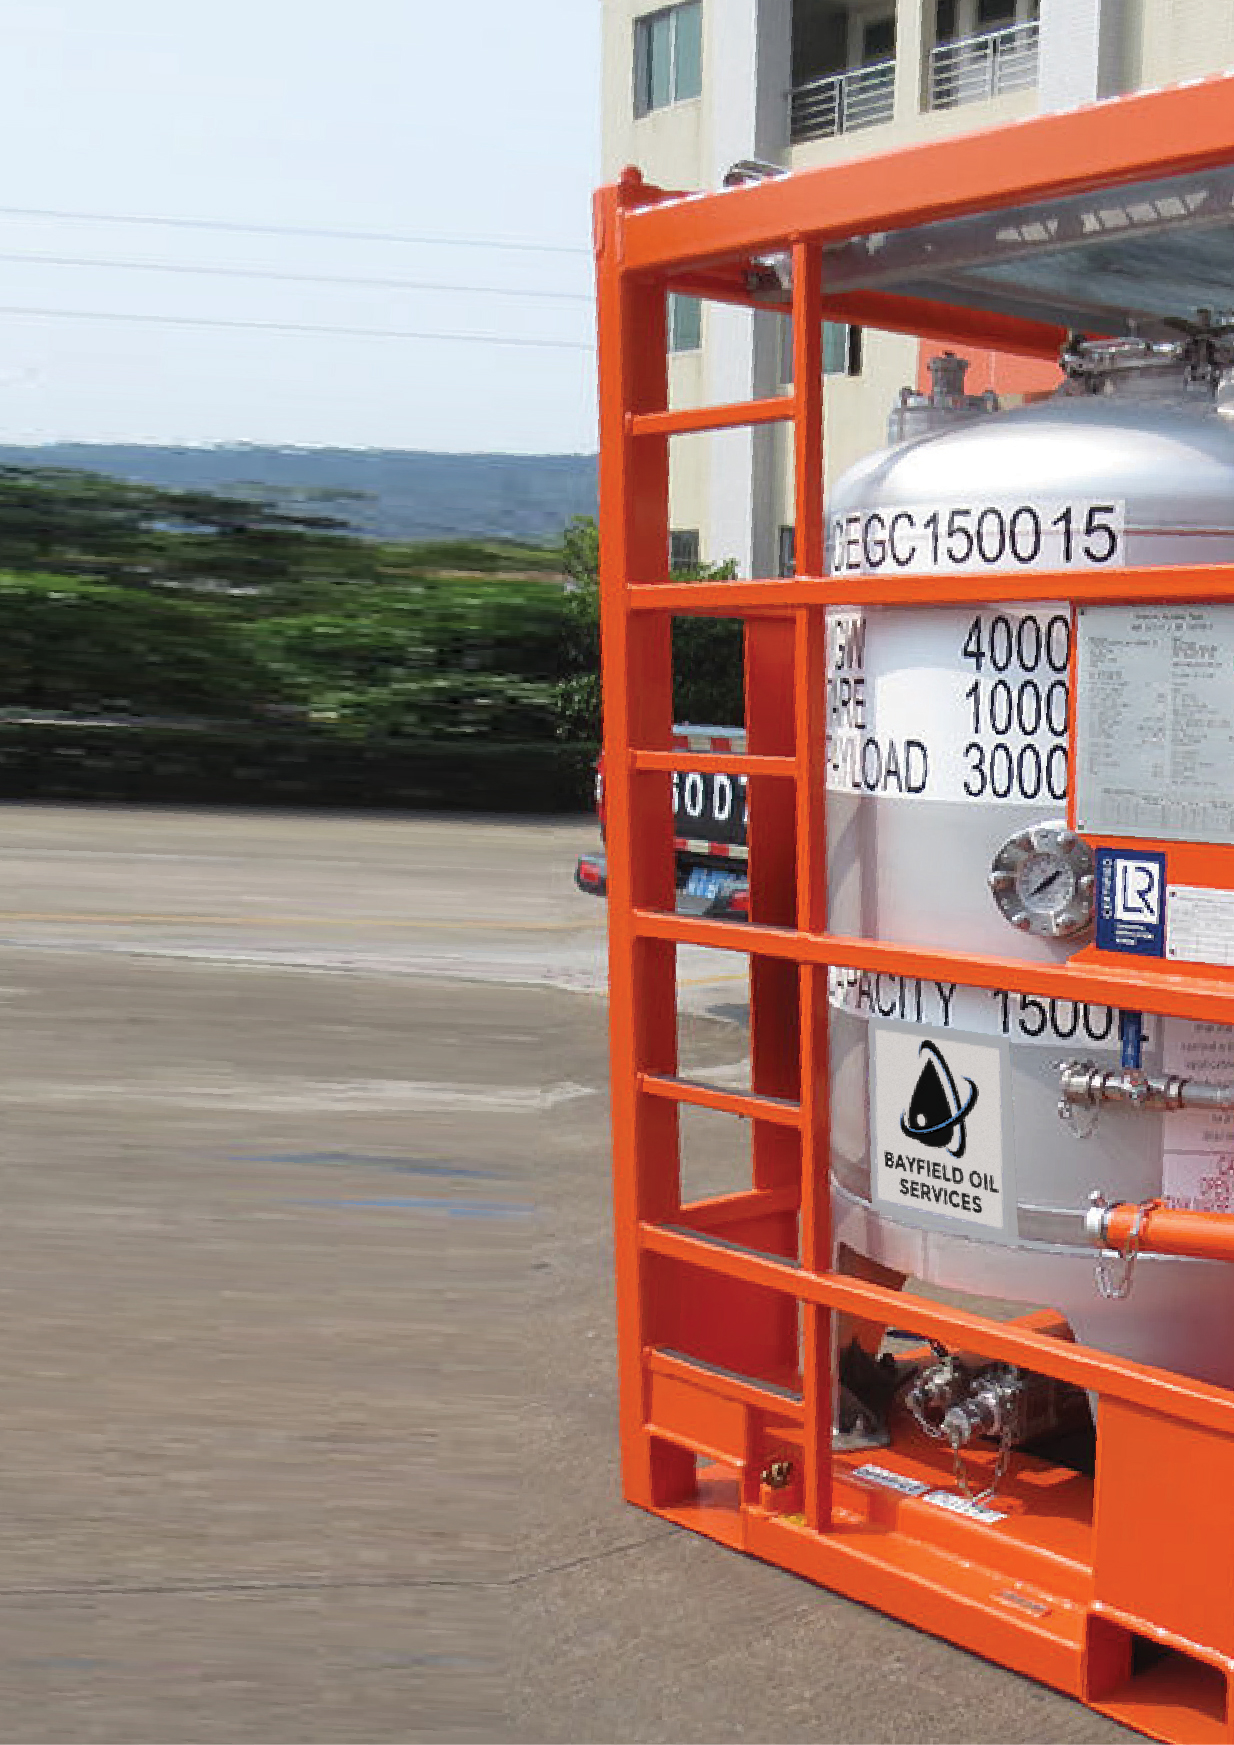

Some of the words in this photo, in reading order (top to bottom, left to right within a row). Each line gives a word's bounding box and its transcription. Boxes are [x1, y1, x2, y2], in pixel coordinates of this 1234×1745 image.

[963, 615, 1069, 673] 4000
[966, 678, 1069, 736] 1000
[964, 741, 1068, 800] 3000
[884, 1150, 964, 1185] BAYFIELD
[969, 1170, 1000, 1194] OIL
[899, 1177, 983, 1214] SERVICES
